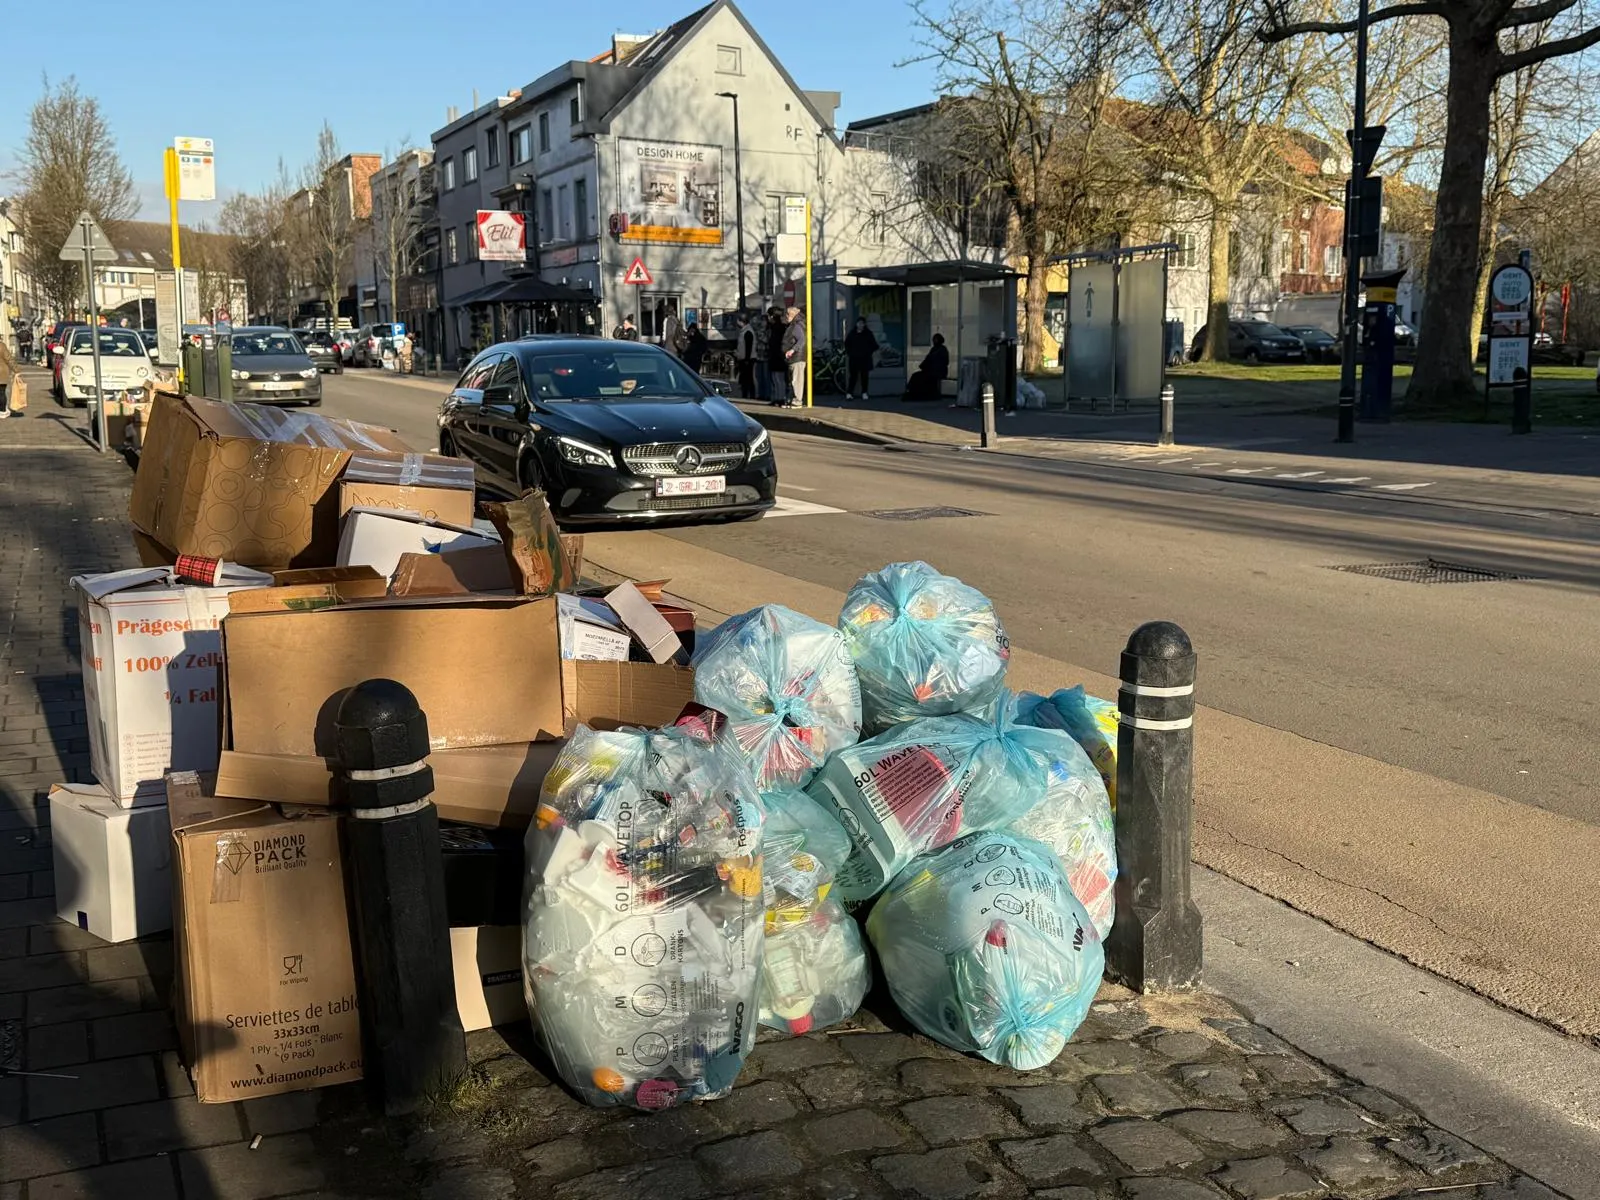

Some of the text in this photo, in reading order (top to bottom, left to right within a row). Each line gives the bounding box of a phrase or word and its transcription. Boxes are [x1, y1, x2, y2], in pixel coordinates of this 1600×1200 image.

[637, 147, 704, 162] DESIGN HOME
[124, 655, 179, 673] 100%
[733, 799, 747, 848] Fostplus
[254, 834, 305, 852] DIAMOND
[616, 801, 632, 876] WAVETOP
[254, 845, 307, 865] PACK
[255, 859, 307, 873] Brilliant Quality
[615, 946, 627, 956] D
[290, 976, 309, 985] Wiping
[615, 996, 627, 1009] M
[226, 1010, 300, 1029] Serviettes
[305, 1003, 323, 1020] de
[274, 1024, 320, 1039] 33x33cm
[257, 1045, 271, 1055] Ply
[280, 1041, 292, 1051] 1/4
[295, 1039, 312, 1049] Fois
[320, 1032, 343, 1043] Blanc
[616, 1047, 628, 1056] P
[281, 1049, 315, 1063] (9 Pack)
[231, 1059, 364, 1089] www.diamondpack.eu
